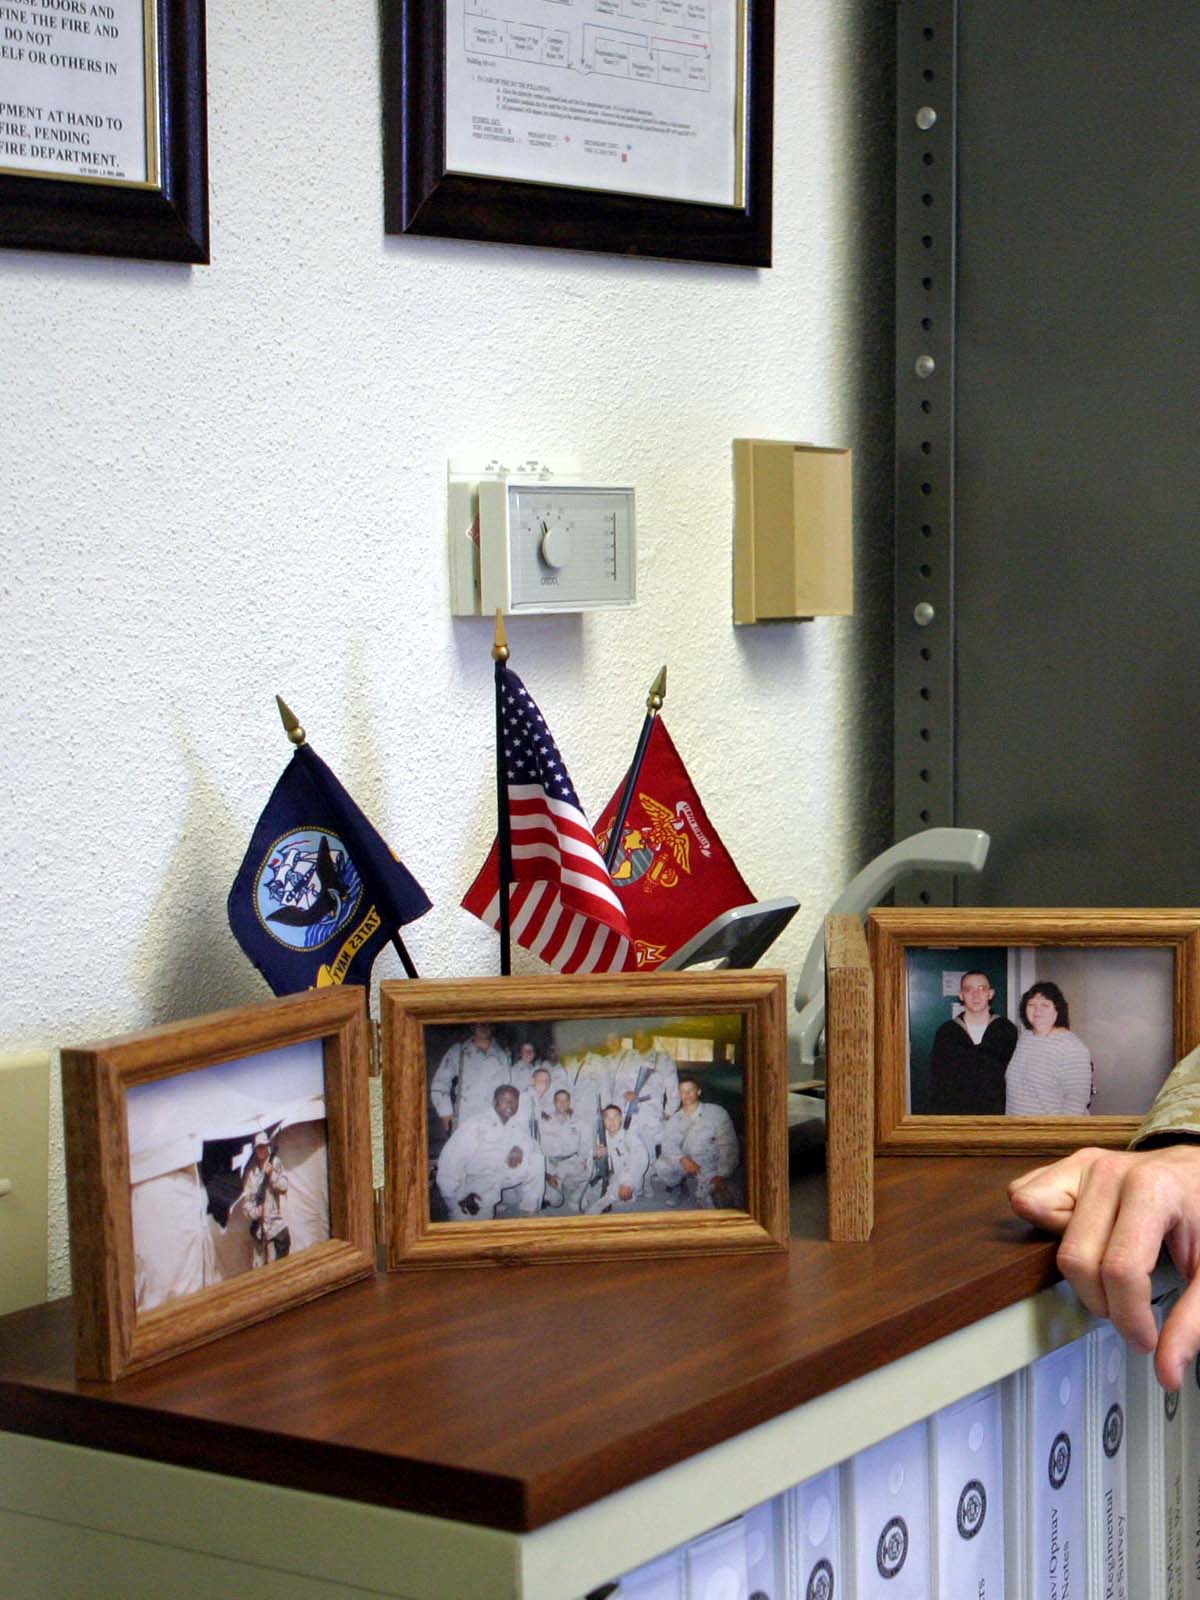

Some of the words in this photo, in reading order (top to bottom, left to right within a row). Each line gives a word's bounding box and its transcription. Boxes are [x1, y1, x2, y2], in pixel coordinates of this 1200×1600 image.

[89, 5, 115, 19] AND
[4, 27, 23, 42] DO
[26, 31, 52, 46] NOT
[31, 13, 57, 29] THE
[61, 18, 91, 34] FIRE
[94, 24, 119, 39] AND
[28, 50, 47, 65] OR
[50, 54, 102, 73] OTHERS
[105, 61, 118, 76] IN
[47, 110, 64, 124] AT
[67, 112, 103, 129] HAND
[106, 117, 122, 131] TO
[34, 126, 90, 146] PENDING
[31, 144, 119, 168] DEPARTMENT.
[1105, 1489, 1115, 1600] Regimental
